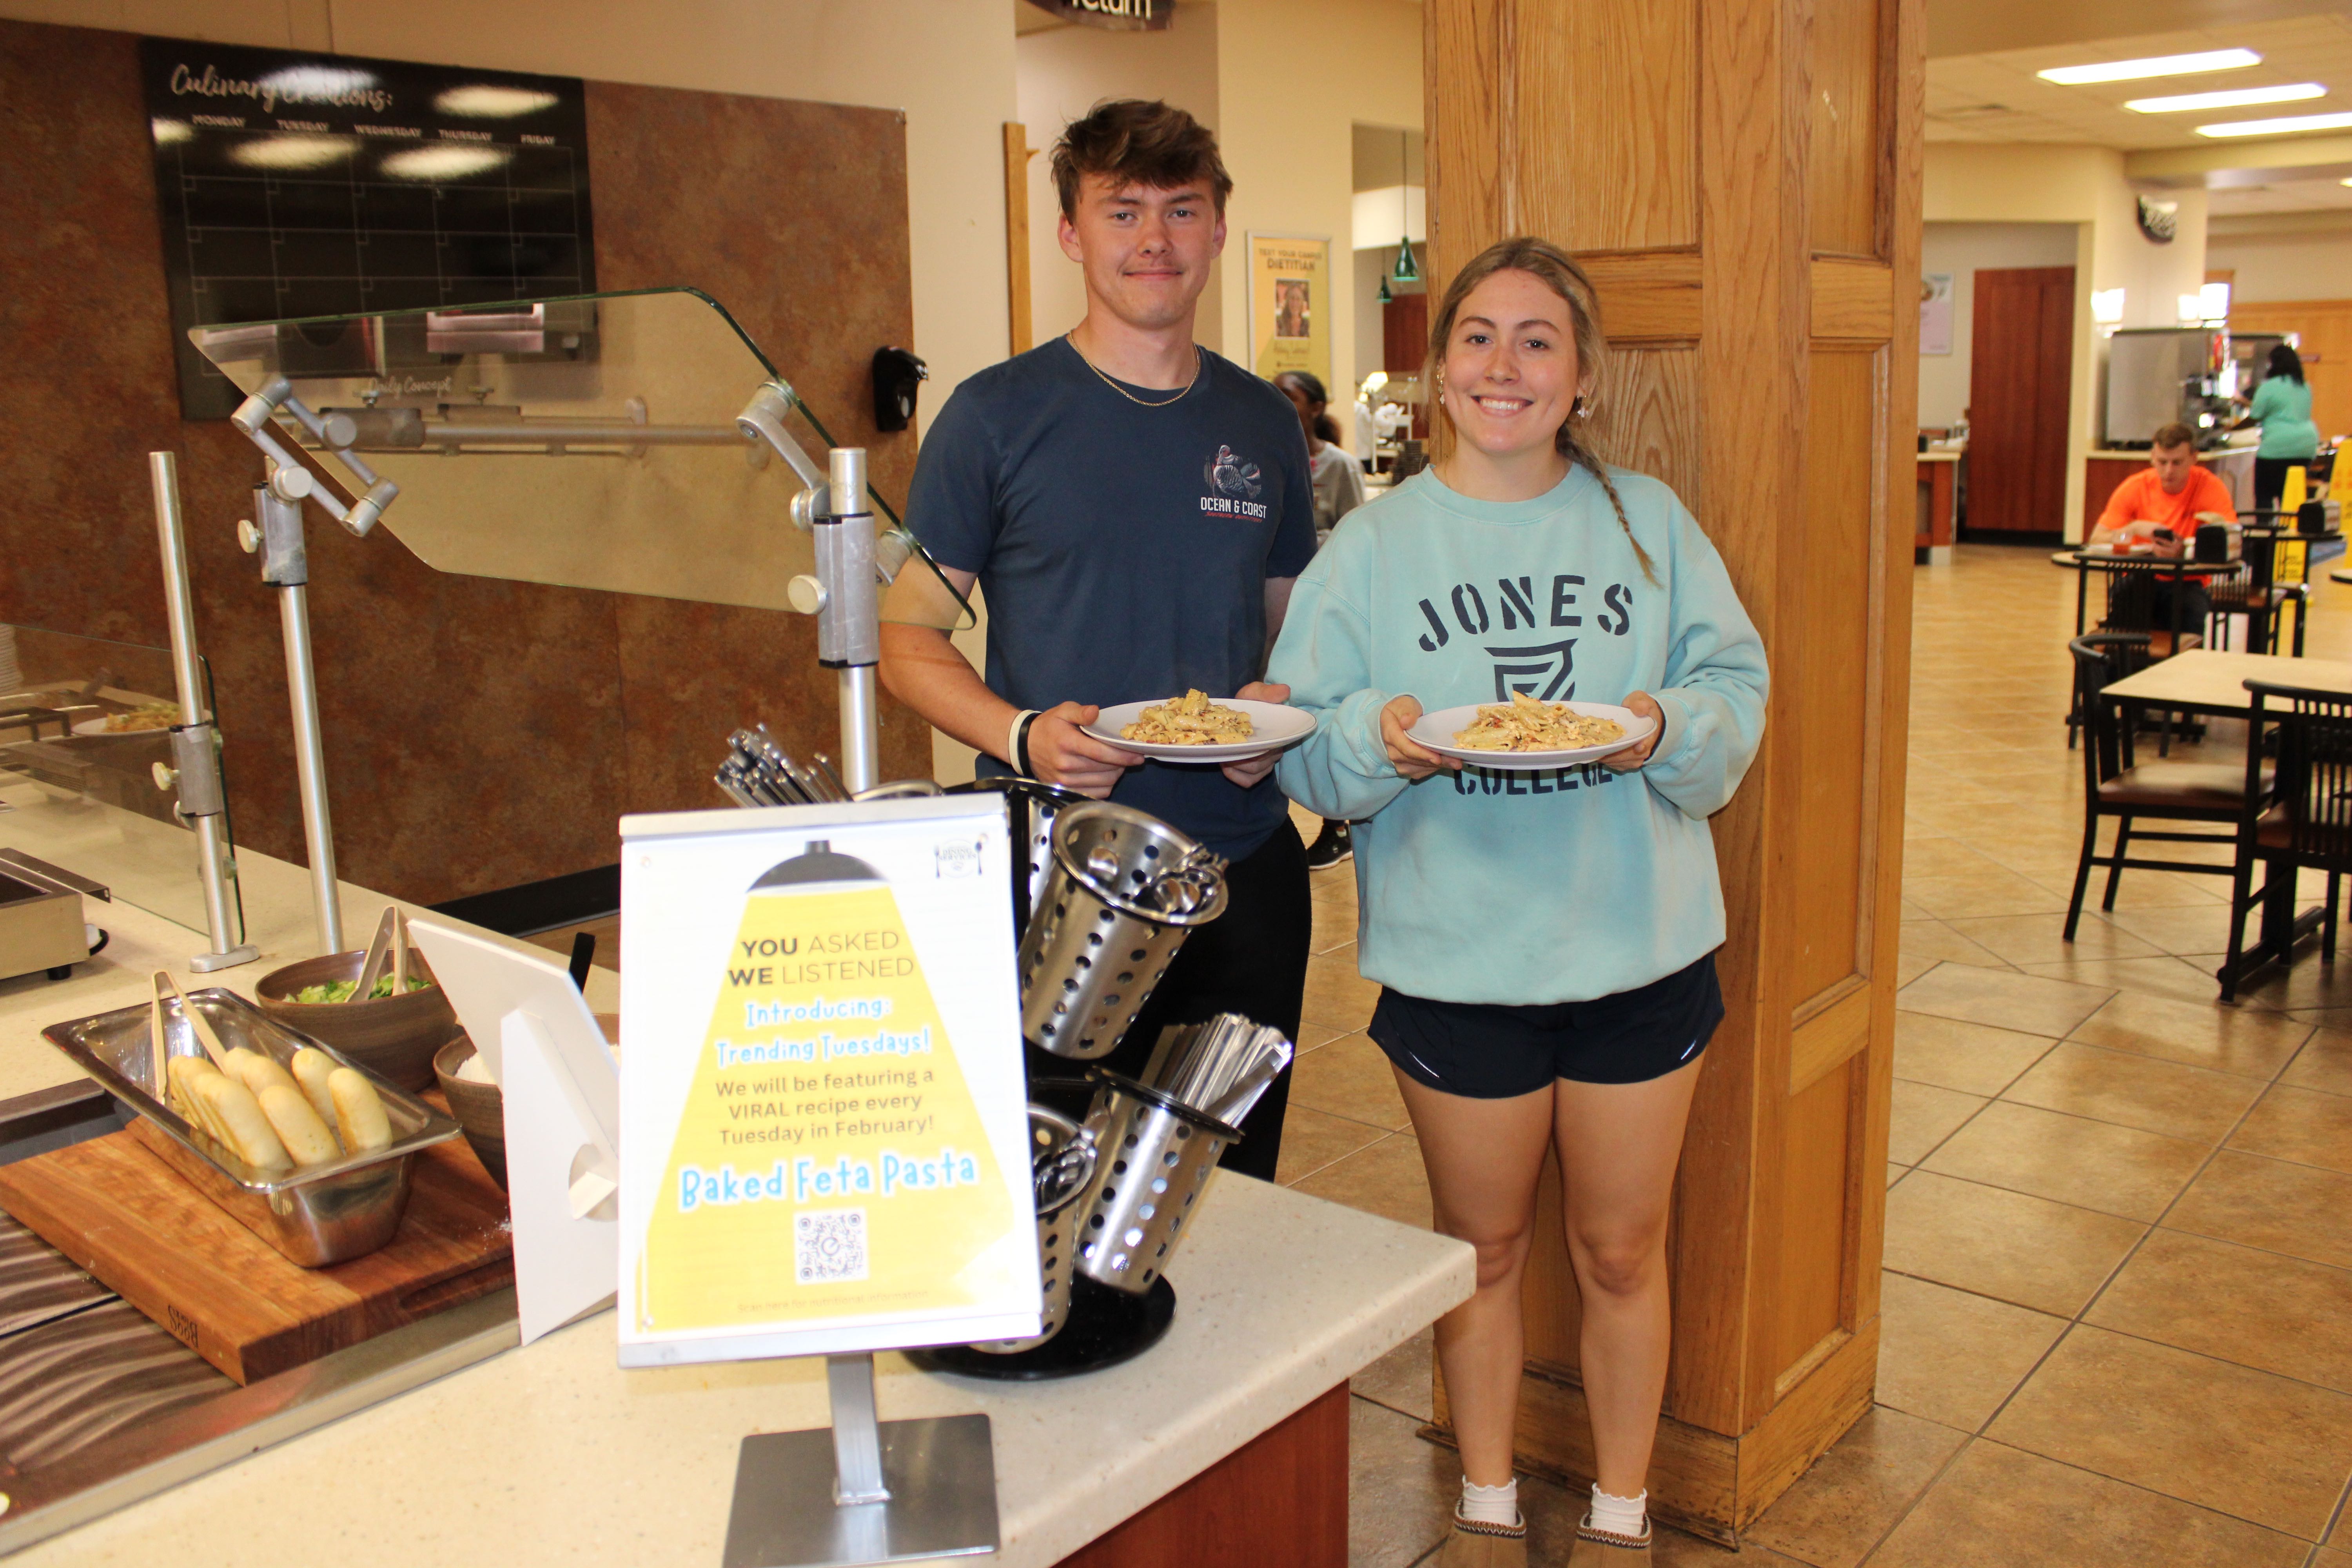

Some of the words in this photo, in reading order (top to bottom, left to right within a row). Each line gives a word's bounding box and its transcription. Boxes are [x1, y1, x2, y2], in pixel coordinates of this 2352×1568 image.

[171, 64, 276, 114] Culinary
[192, 114, 245, 127] MONDAY
[276, 119, 330, 132] TUESDAY
[354, 124, 422, 138] WEDNESDAY
[439, 129, 492, 141] THURSDAY
[521, 134, 555, 146] FRIDAY
[1267, 257, 1315, 271] DIETITIAN
[1200, 497, 1231, 513] OCEAN
[1234, 500, 1240, 514] &
[1242, 501, 1267, 519] COAST
[1419, 575, 1632, 652] JONES
[741, 938, 797, 958] YOU
[808, 931, 899, 955] ASKED
[728, 967, 773, 987] WE
[783, 958, 913, 984] LISTENED
[746, 1000, 891, 1027] Introducing:
[717, 1040, 813, 1067] Trending
[821, 1028, 929, 1058] Tuesdays!
[716, 1082, 746, 1097] We
[753, 1077, 787, 1094] will
[794, 1077, 817, 1091] be
[824, 1070, 916, 1089] featuring
[923, 1071, 934, 1082] a
[729, 1102, 789, 1120] VIRAL
[797, 1098, 859, 1116] recipe
[866, 1095, 922, 1111] every
[720, 1126, 804, 1145] Tuesday
[811, 1123, 828, 1138] in
[836, 1115, 934, 1137] February!
[682, 1165, 782, 1209] Baked
[797, 1160, 869, 1200] Feta
[884, 1153, 975, 1194] Pasta
[737, 1303, 762, 1313] Scan
[765, 1300, 789, 1311] here
[791, 1298, 807, 1309] for
[809, 1293, 865, 1308] nutritional
[867, 1289, 928, 1303] information
